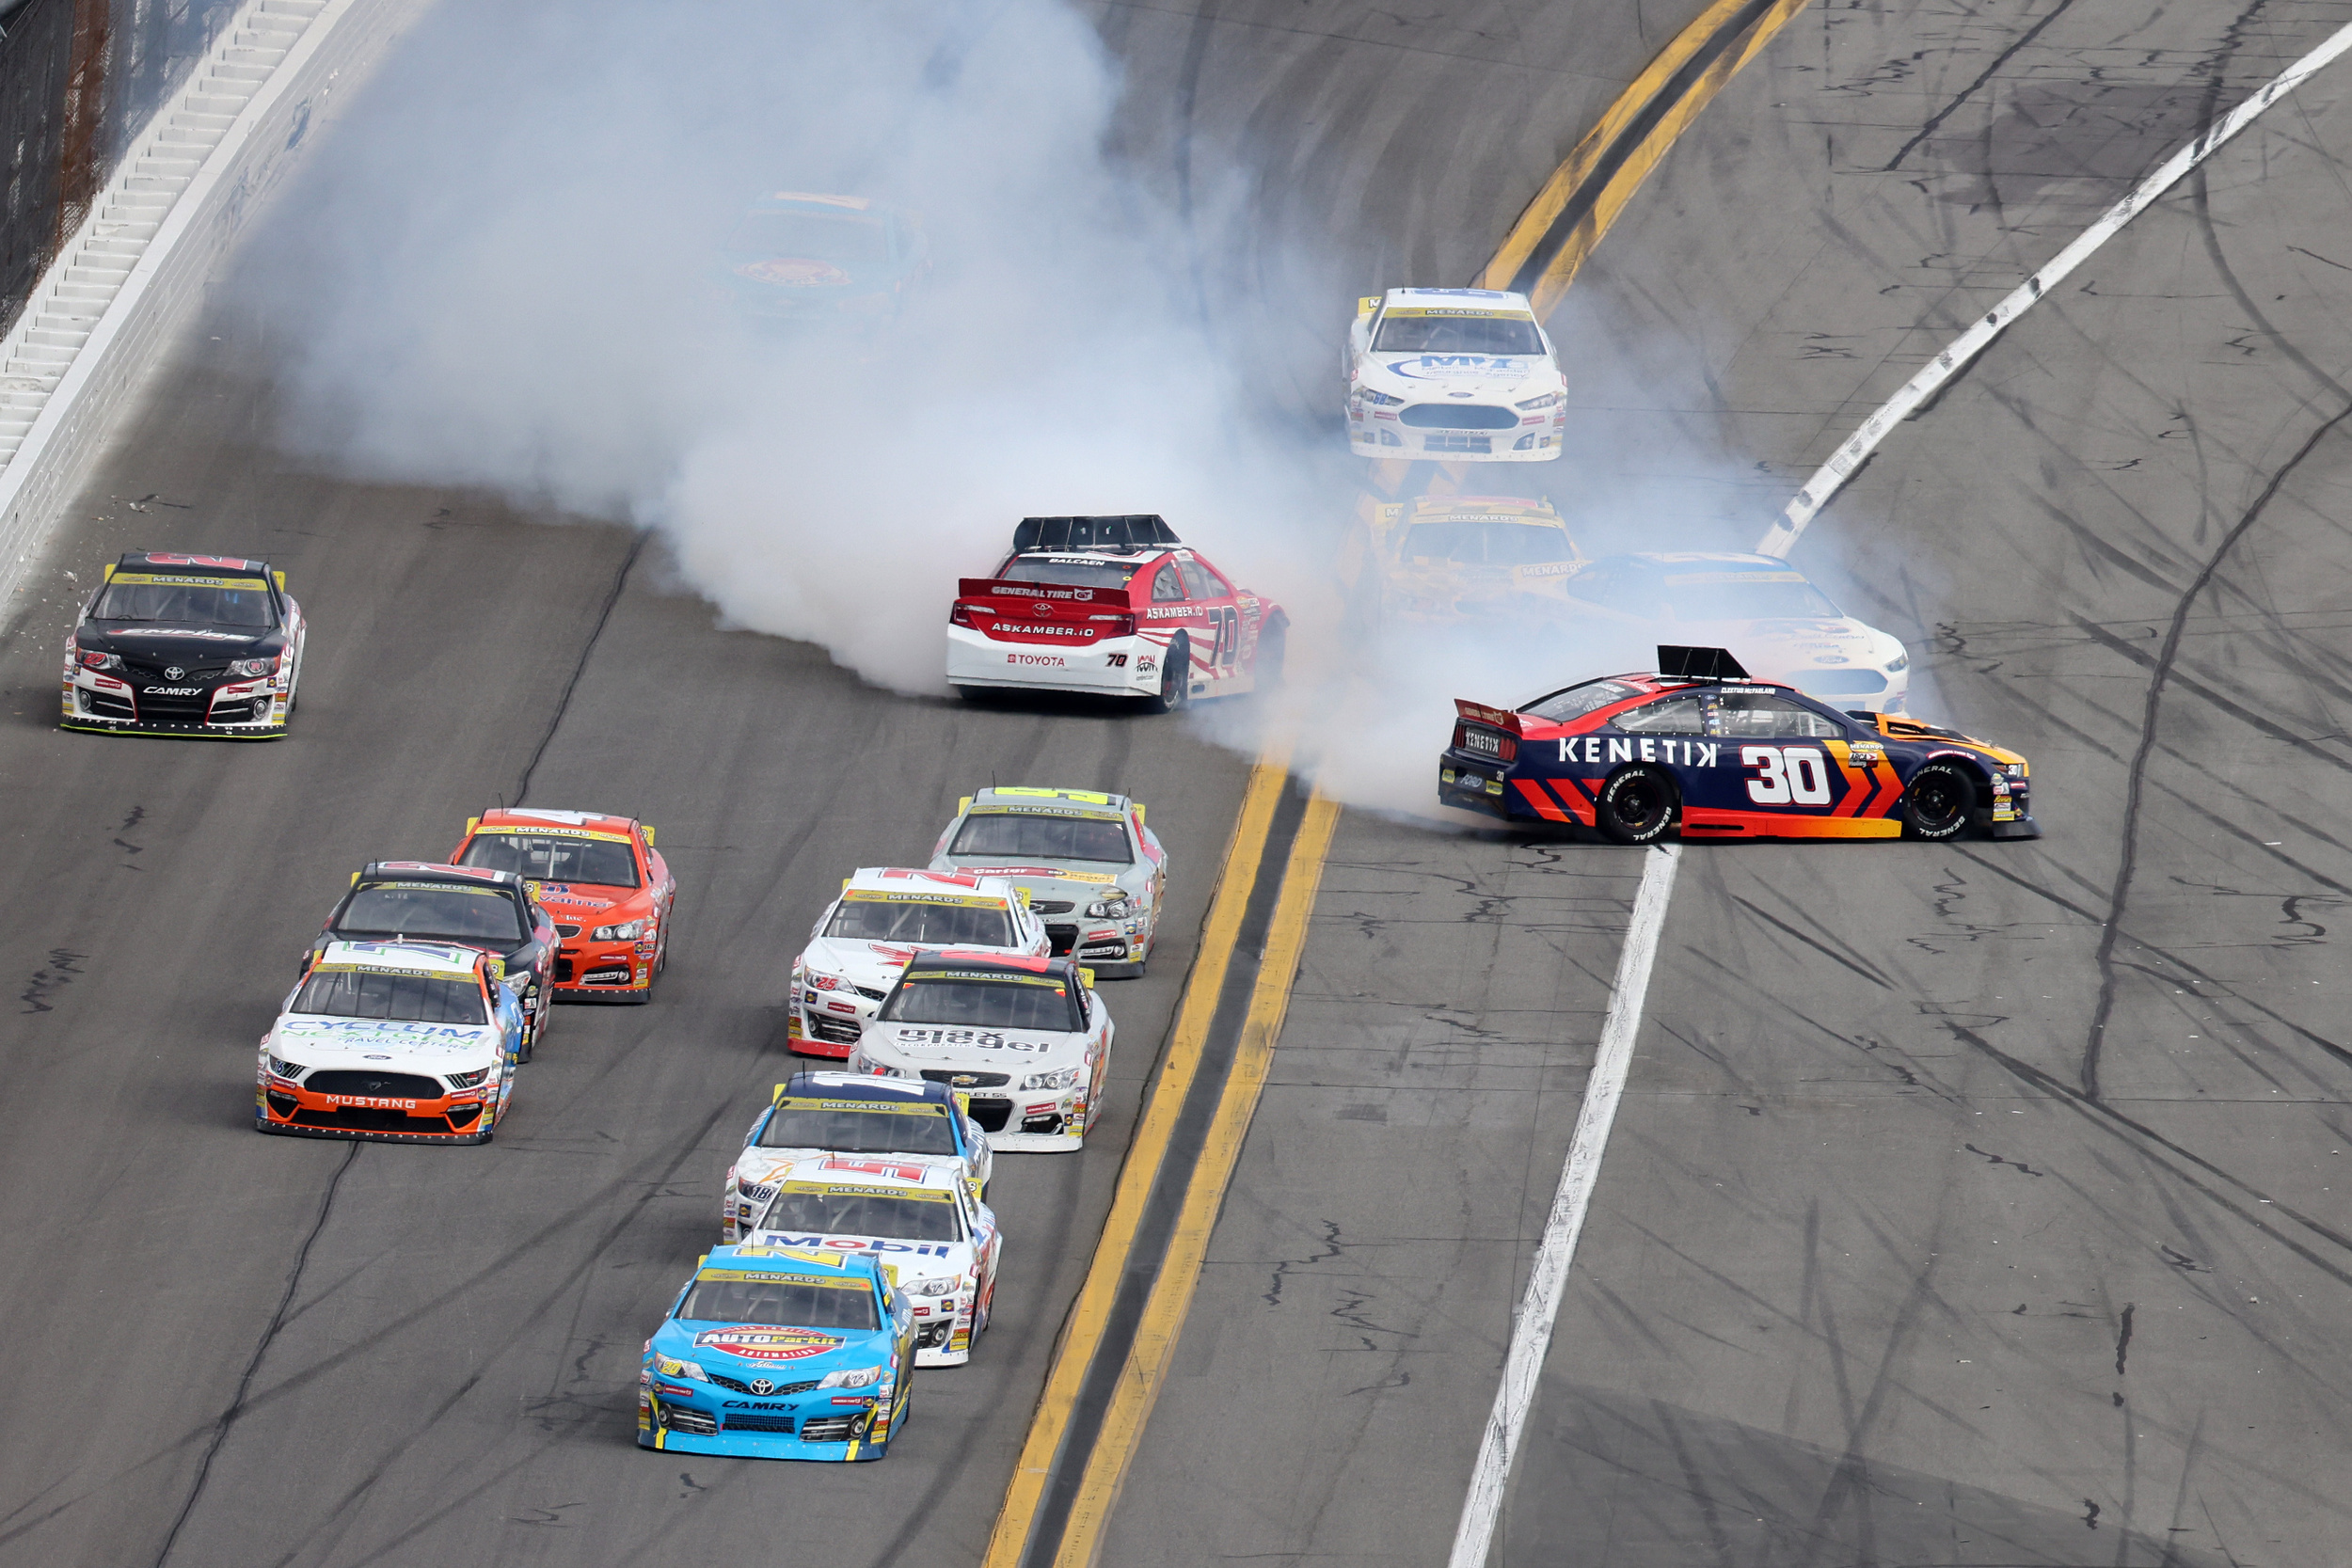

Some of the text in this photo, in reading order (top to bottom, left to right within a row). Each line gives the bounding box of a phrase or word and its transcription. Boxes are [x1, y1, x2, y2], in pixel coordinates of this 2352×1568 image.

[1049, 558, 1104, 566] BALCAEN
[152, 577, 224, 586] MENARDS
[992, 586, 1073, 599] GENERAL TIRE
[1206, 605, 1238, 670] 70
[1019, 655, 1065, 667] TOYOTA
[1105, 654, 1128, 668] 70
[143, 686, 203, 696] CAMRY
[1559, 737, 1717, 768] KENETIK
[1460, 774, 1483, 787] FORD
[1740, 743, 1833, 806] 30
[1607, 769, 1645, 802] GENERAL
[1008, 806, 1083, 816] MENARDS
[1633, 806, 1673, 841] GENERAL
[1919, 816, 1965, 837] GENERAL
[516, 826, 590, 836] MENARDS
[396, 881, 472, 892] MENARDS
[887, 894, 963, 904] MENARDS
[357, 964, 433, 977] MENARDS
[946, 971, 1024, 982] MENARDS
[816, 976, 838, 990] 25
[326, 1096, 416, 1109] MUSTANG
[821, 1101, 899, 1112] MENARDS
[751, 1185, 773, 1200] 18
[828, 1185, 907, 1196] MENARDS
[763, 1234, 951, 1259] Mobil
[744, 1273, 827, 1285] MENARDS
[739, 1349, 817, 1358] AUTOMATION
[660, 1360, 683, 1375] 20
[722, 1400, 801, 1411] CAMRY
